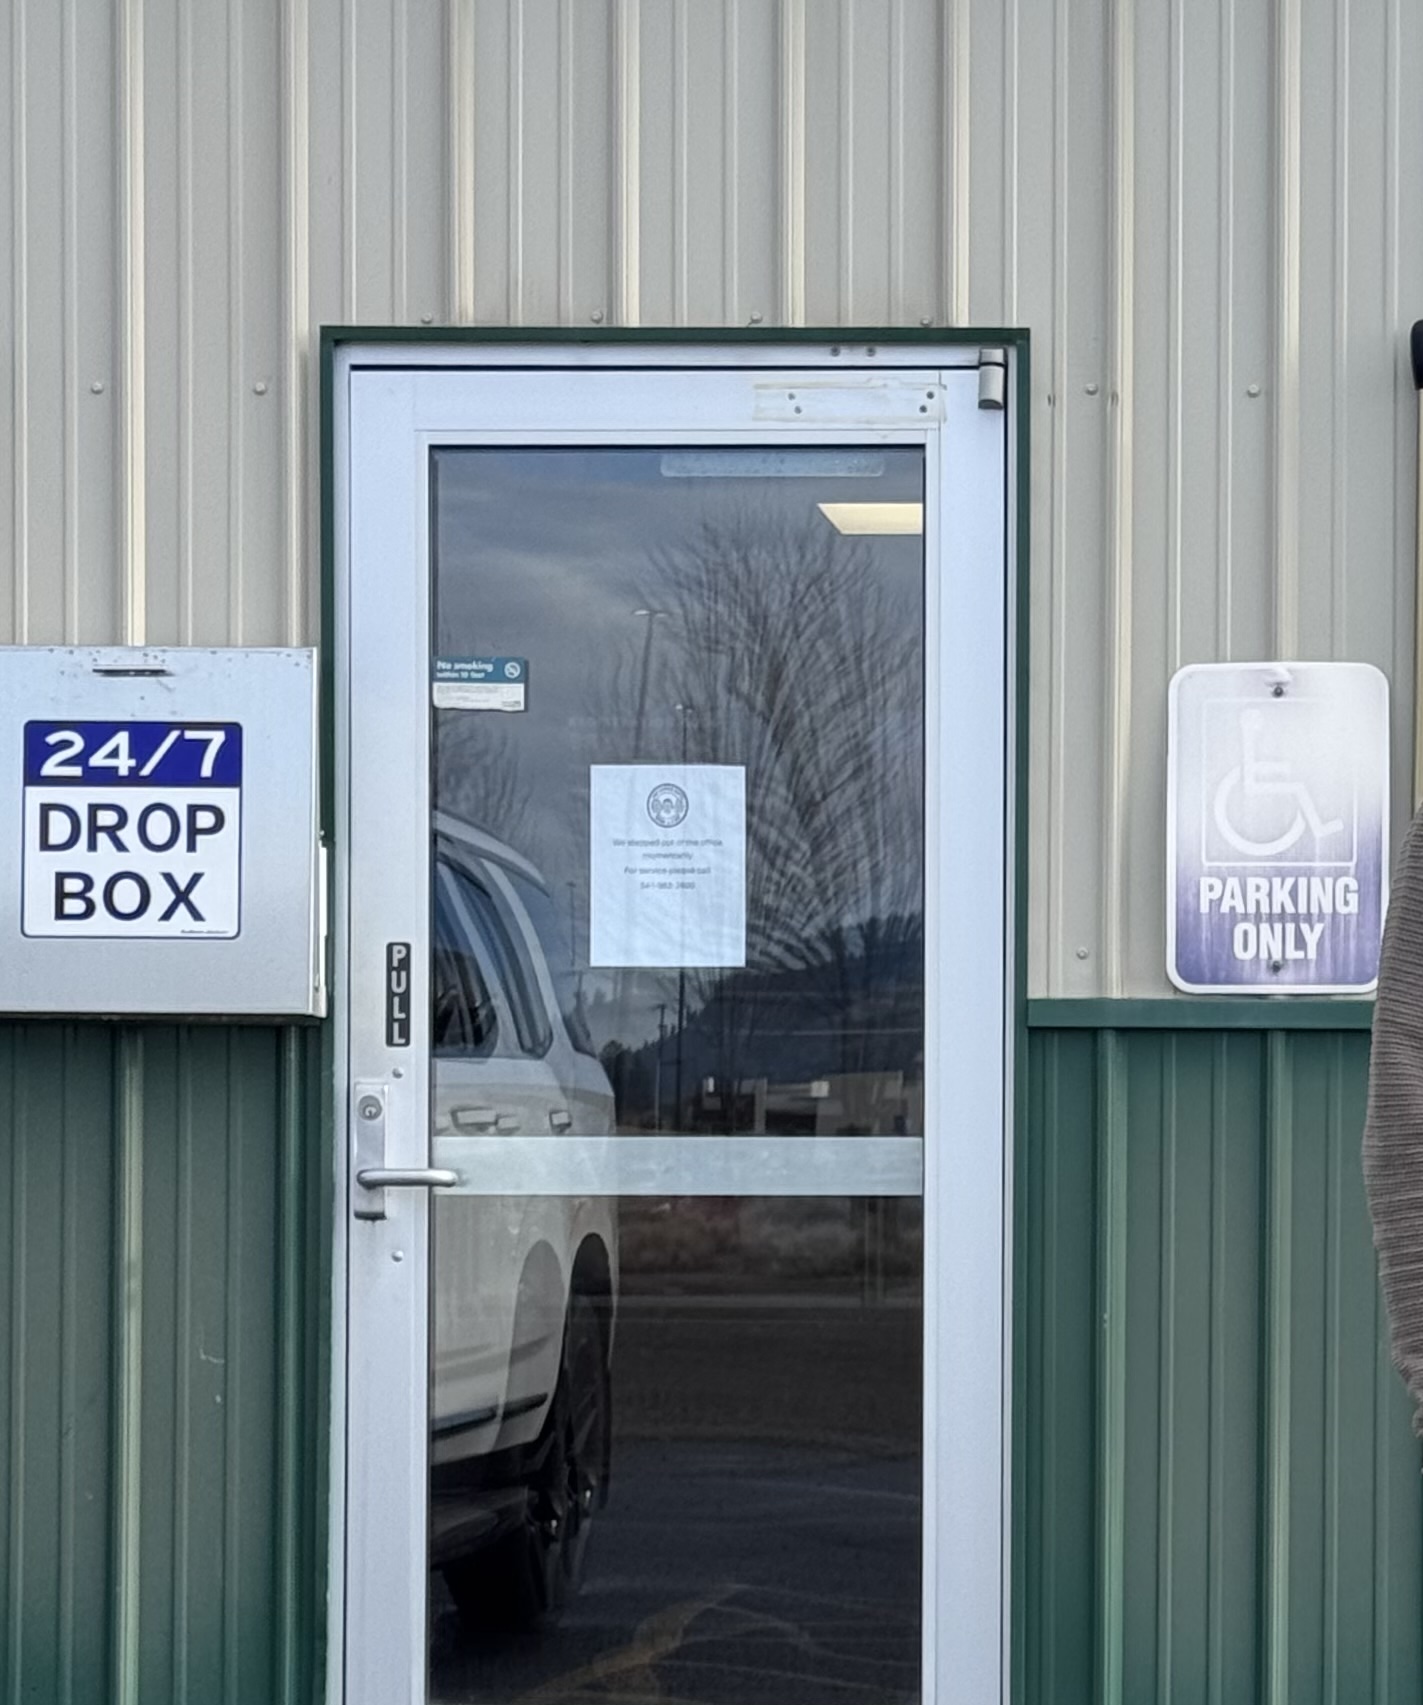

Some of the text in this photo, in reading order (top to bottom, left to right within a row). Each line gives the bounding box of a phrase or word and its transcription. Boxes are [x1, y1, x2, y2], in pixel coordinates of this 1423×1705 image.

[436, 660, 493, 673] No smoking
[39, 730, 227, 778] 24/7
[38, 802, 226, 854] DROP
[627, 838, 660, 849] stepped
[624, 866, 637, 875] For
[638, 867, 667, 875] service
[53, 870, 207, 922] BOX
[1199, 876, 1359, 915] PARKING
[1232, 922, 1325, 961] ONLY
[390, 944, 407, 1044] PULL
